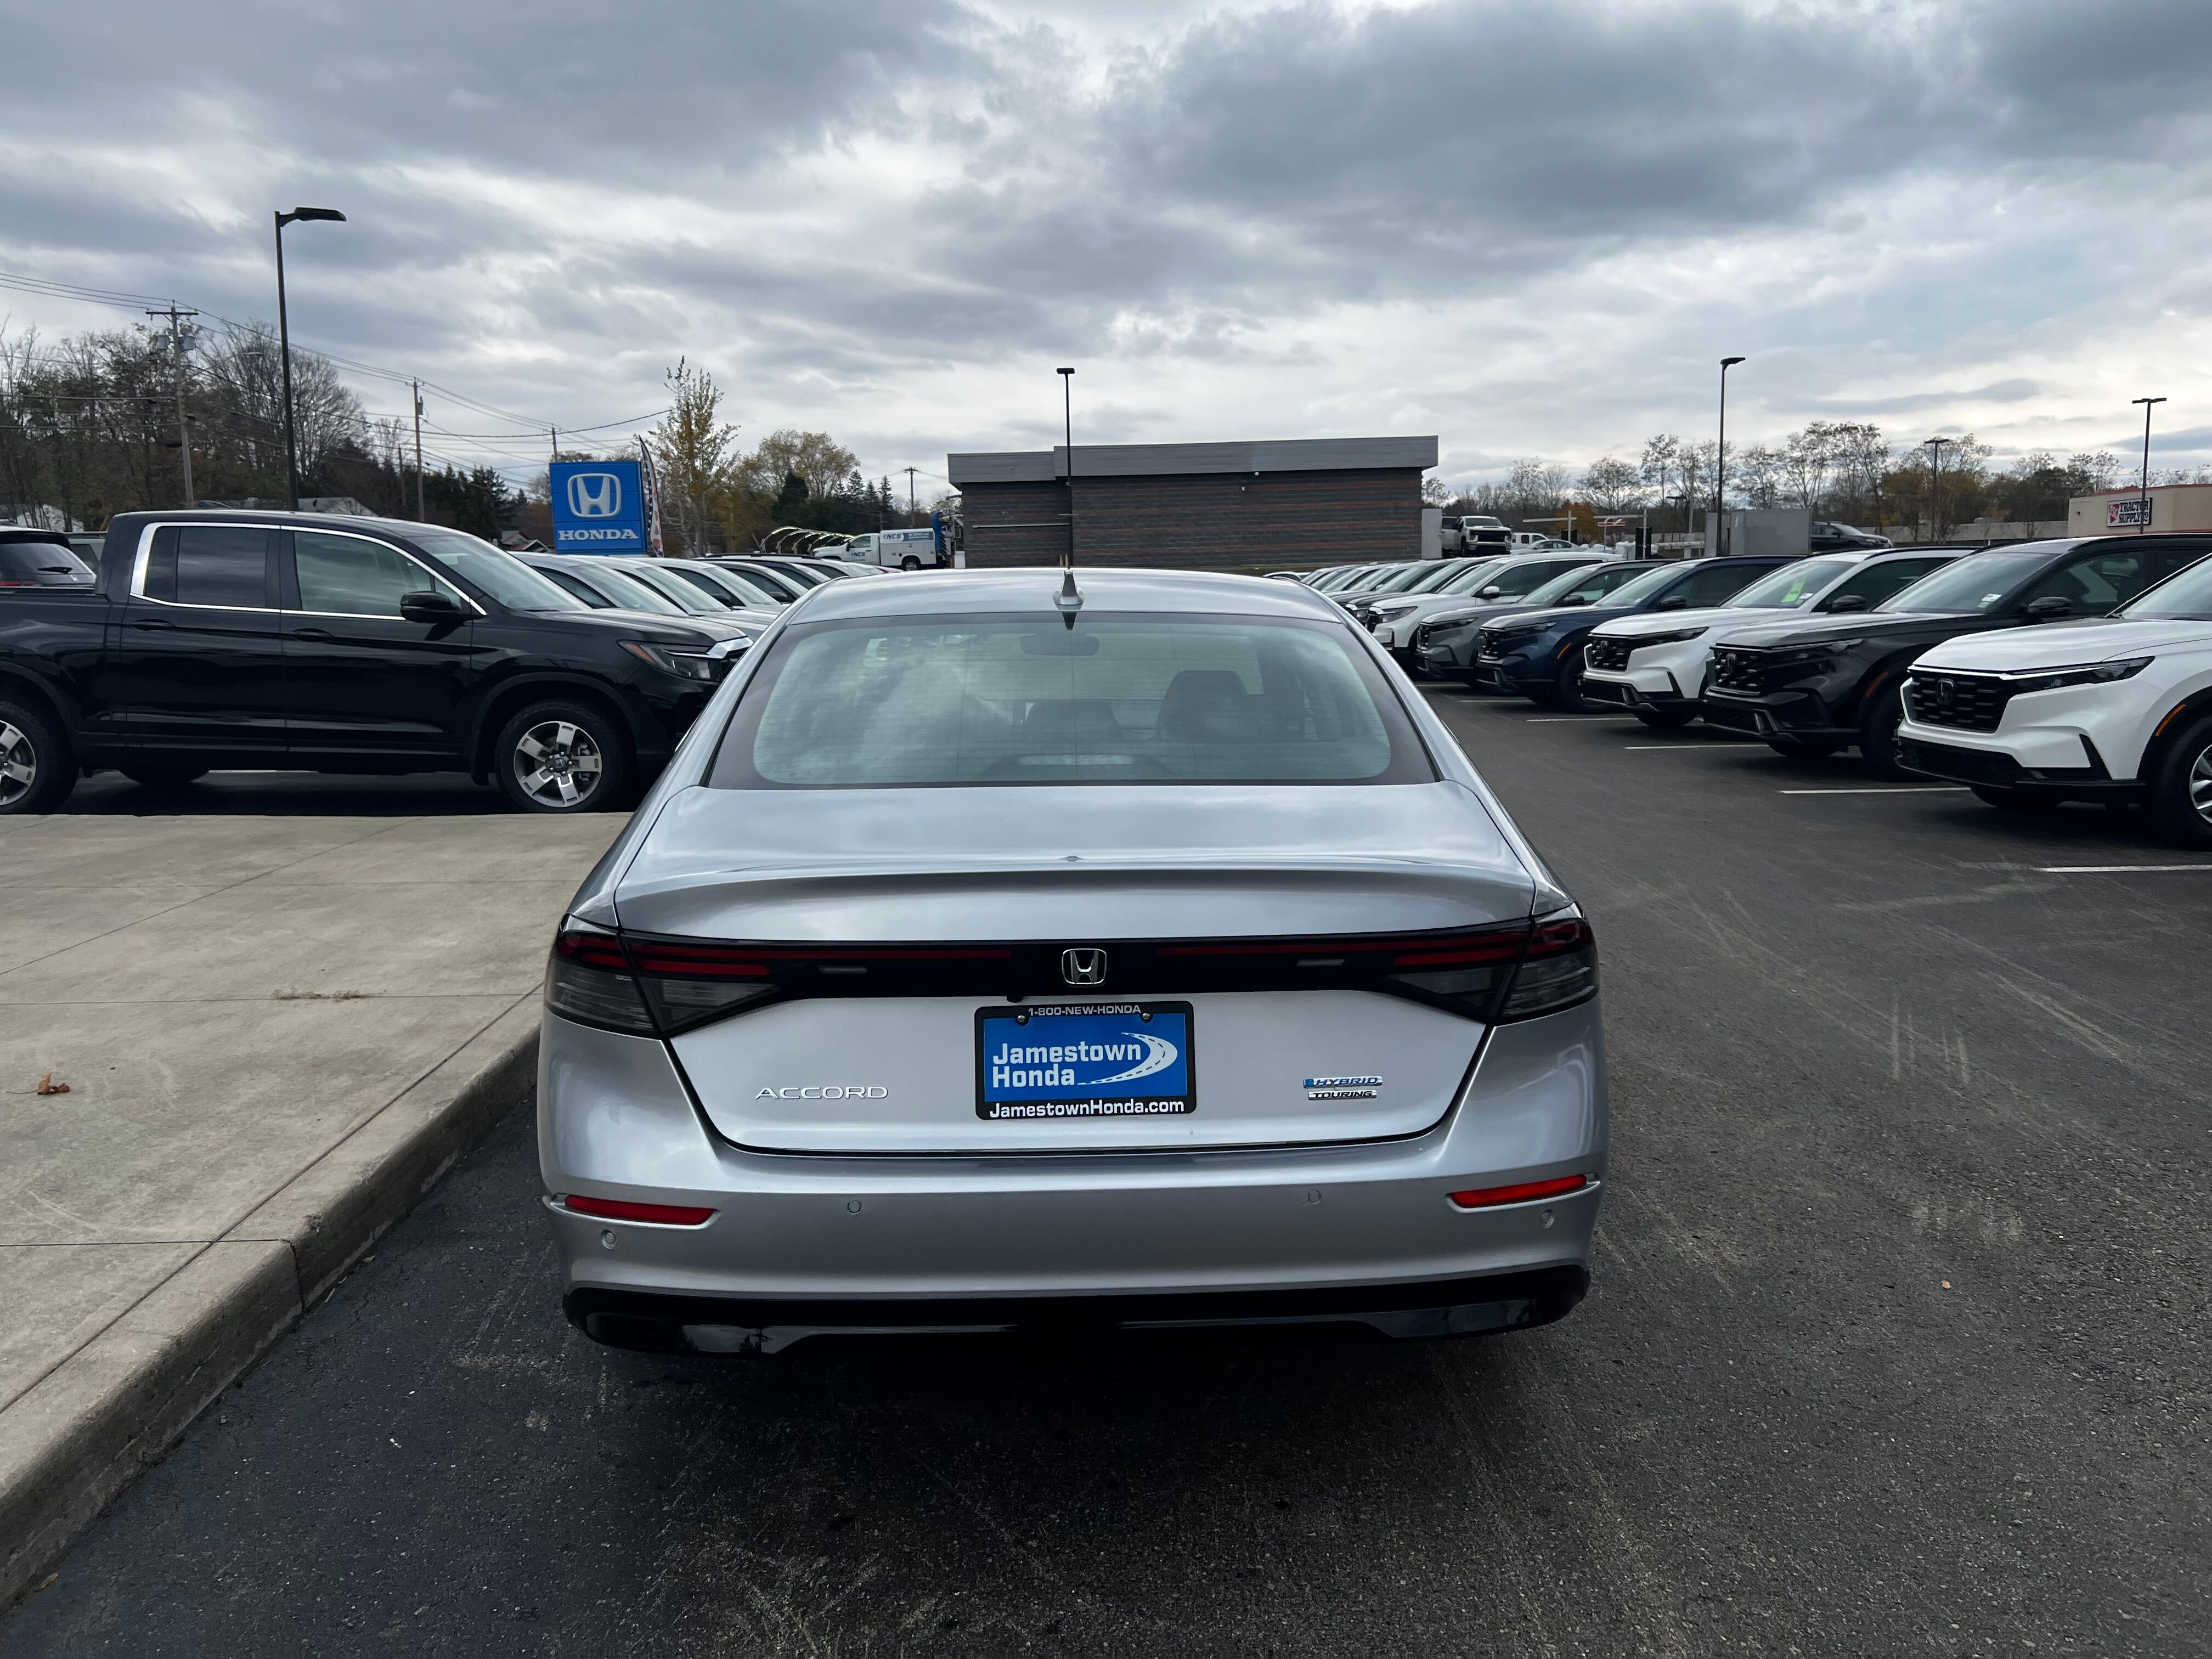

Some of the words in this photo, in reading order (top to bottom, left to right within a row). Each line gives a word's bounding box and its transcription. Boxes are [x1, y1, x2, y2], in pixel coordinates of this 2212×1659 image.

[557, 528, 639, 540] HONDA
[1028, 1005, 1141, 1017] 1-800-NEW-HONDA
[992, 1041, 1141, 1065] Jamestown
[992, 1063, 1075, 1088] Honda
[1316, 1077, 1378, 1086] HYBRID
[754, 1086, 888, 1100] ACCORD
[989, 1098, 1184, 1118] JamestownHonda.com
